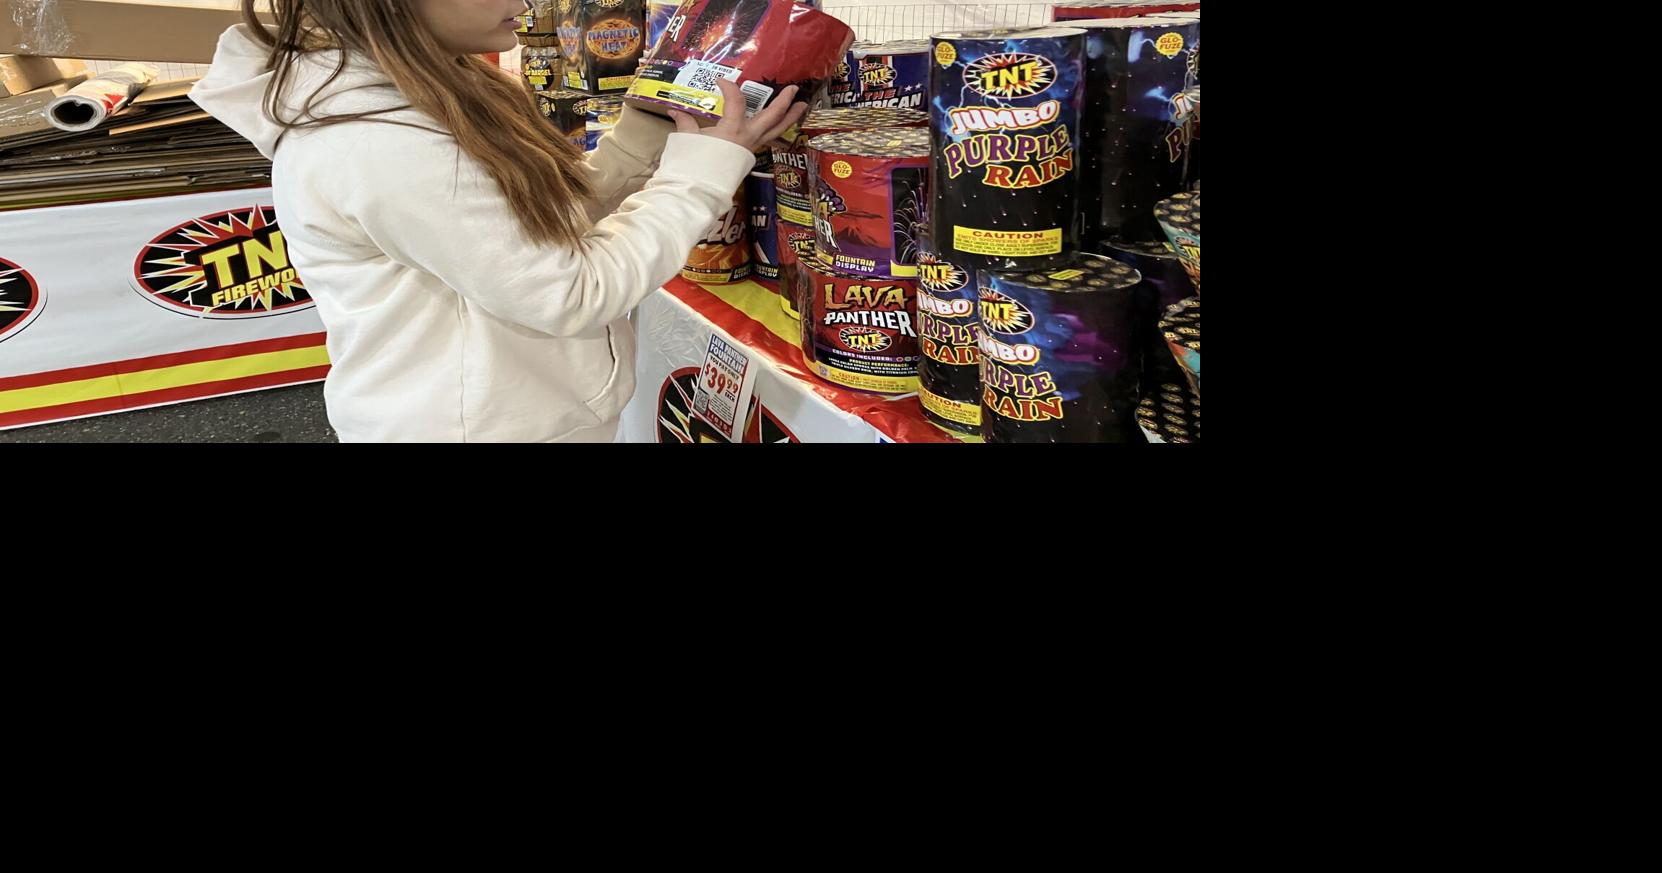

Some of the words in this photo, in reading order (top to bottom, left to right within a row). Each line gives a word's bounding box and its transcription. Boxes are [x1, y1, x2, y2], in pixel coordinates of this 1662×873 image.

[588, 27, 640, 41] MAGNETIC
[602, 41, 626, 53] HEAT
[863, 68, 888, 81] TNT
[981, 61, 1038, 92] TNT
[863, 89, 897, 100] THE
[950, 100, 1060, 136] JUMBO
[944, 124, 1071, 179] PURPLE
[982, 148, 1073, 189] RAIN
[972, 230, 1044, 239] CAUTION
[201, 230, 288, 288] TN
[835, 261, 875, 273] DISPLAY
[836, 254, 876, 267] FOUNTAIN
[919, 263, 951, 280] TNT
[211, 267, 298, 308] FIREWO
[824, 284, 908, 310] LAVA
[980, 300, 1014, 321] TNT
[823, 310, 918, 338] PANTHER
[711, 335, 725, 351] LAVA
[848, 333, 878, 347] TNT
[710, 343, 745, 375] FOUNTAIN
[832, 349, 856, 358] COLORS
[710, 355, 720, 366] YOU
[727, 367, 740, 380] ONLY
[724, 391, 736, 403] EACH
[983, 384, 1064, 422] RAIN
